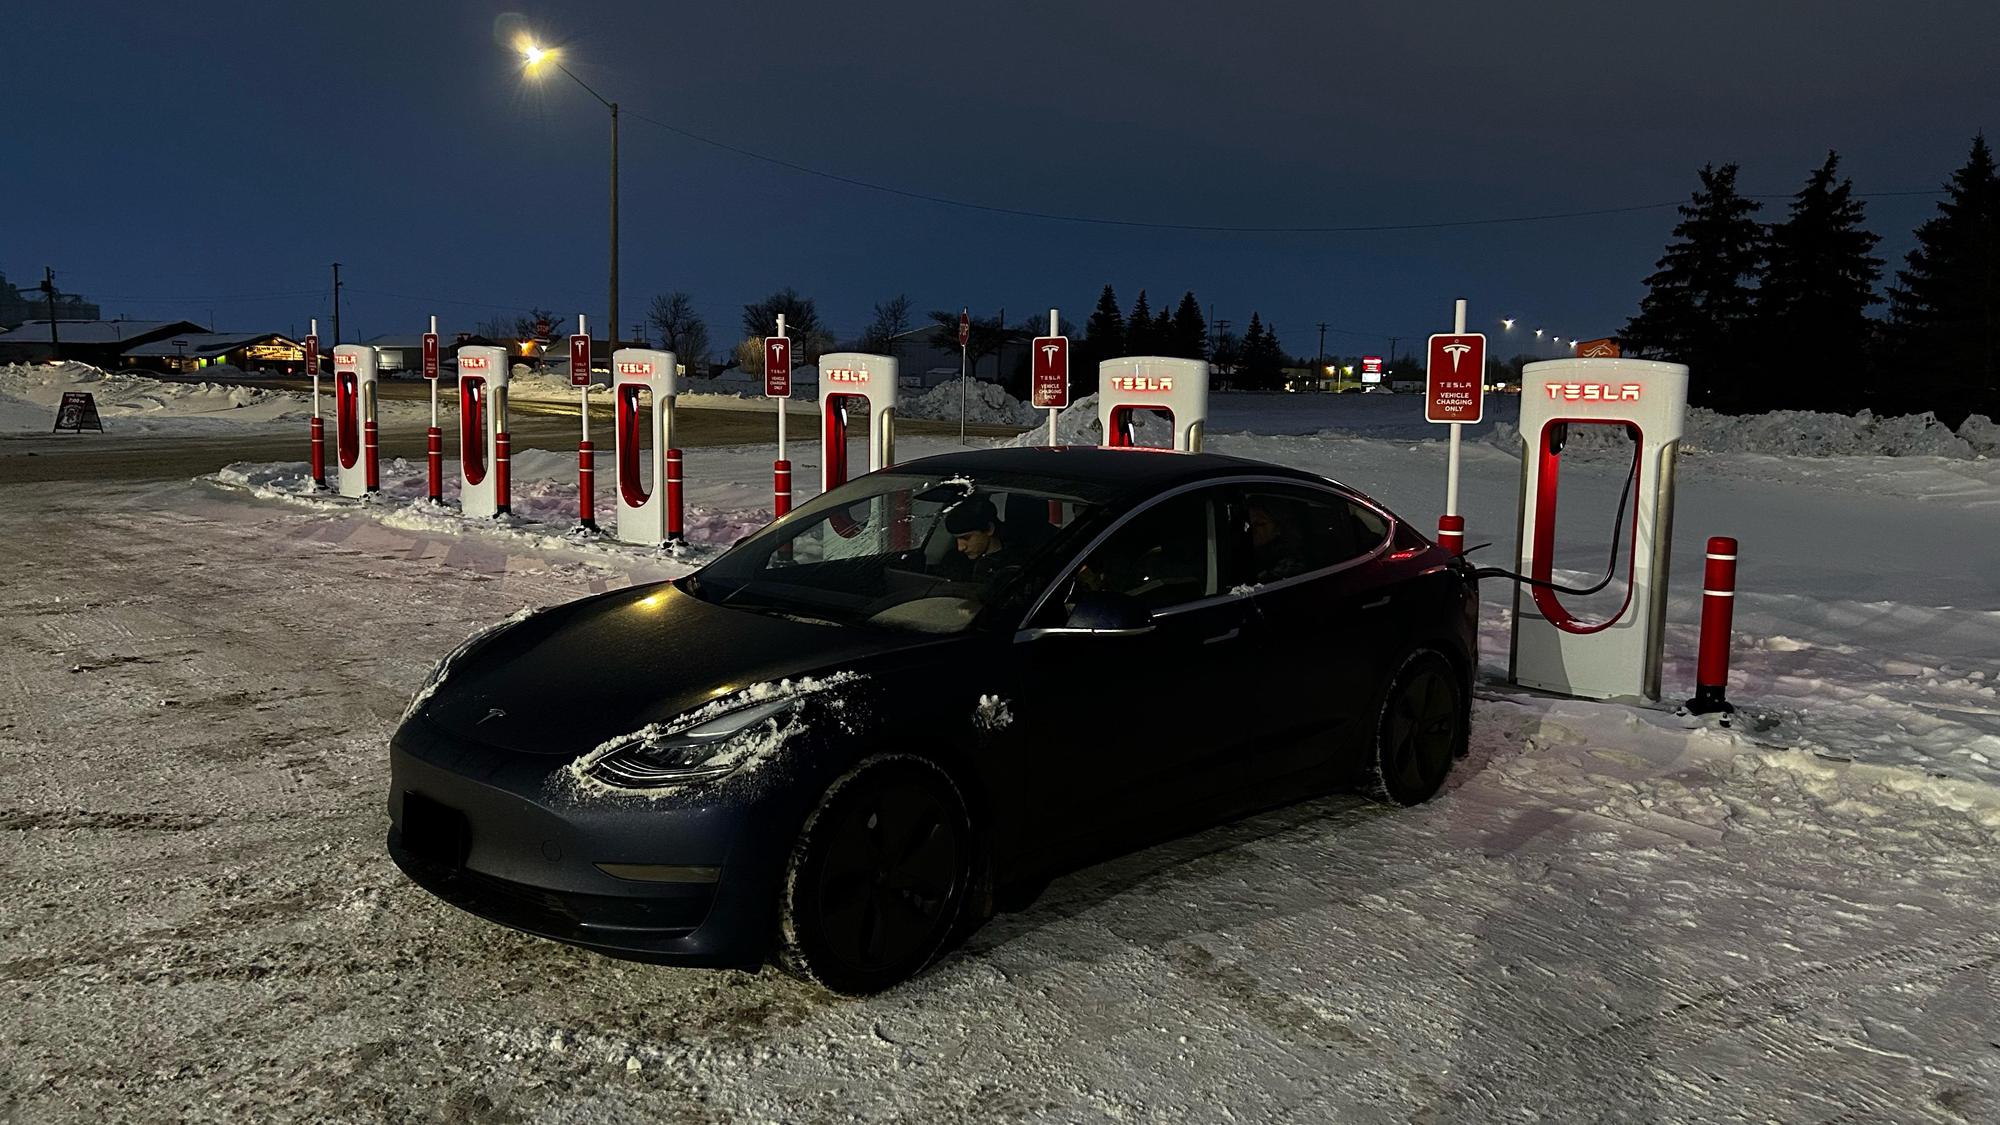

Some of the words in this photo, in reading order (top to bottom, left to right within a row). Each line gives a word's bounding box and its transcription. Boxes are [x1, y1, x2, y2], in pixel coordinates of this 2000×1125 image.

[334, 355, 356, 364] TESLA
[460, 358, 485, 368] TESLA
[617, 363, 651, 374] TESLA
[825, 369, 868, 382] TESLA
[1111, 377, 1173, 391] TESLA
[1546, 384, 1640, 400] TESLA
